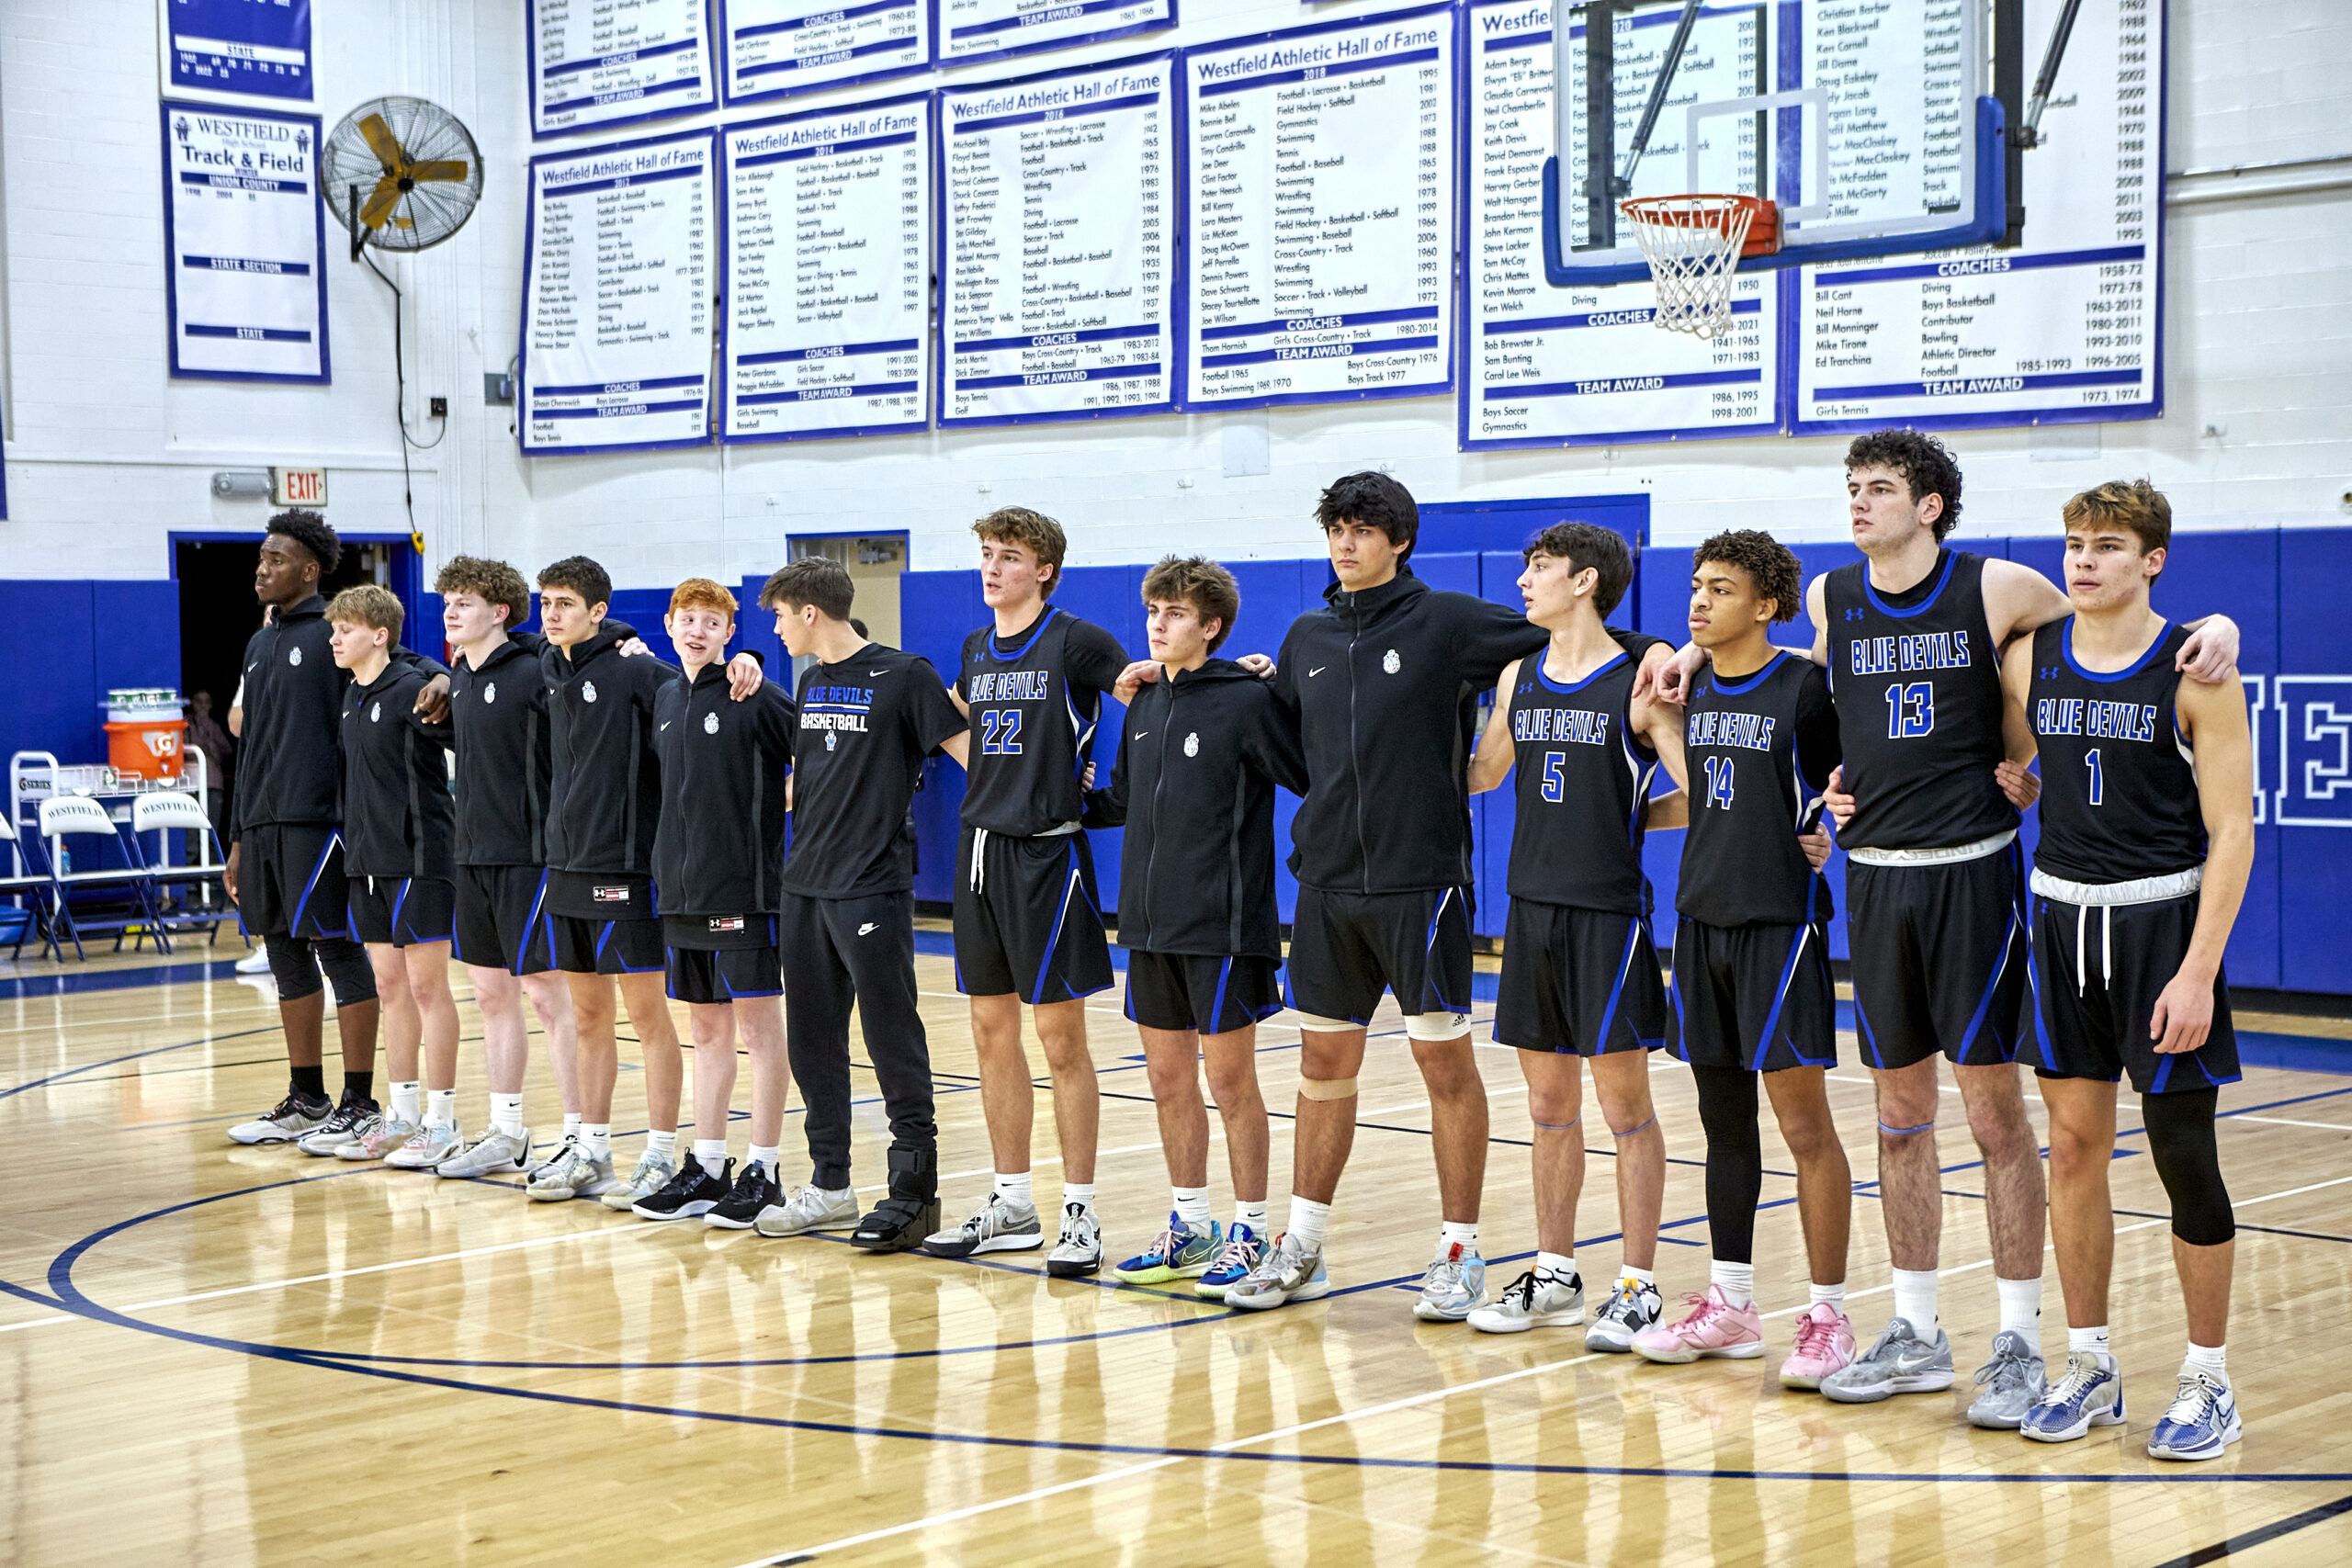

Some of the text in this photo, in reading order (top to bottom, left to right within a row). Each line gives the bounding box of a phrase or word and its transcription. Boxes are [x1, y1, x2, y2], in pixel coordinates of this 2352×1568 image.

[804, 11, 844, 28] COACHES
[1019, 6, 1083, 27] TEAM AWARD
[227, 44, 254, 60] STATE
[950, 38, 999, 53] Boys Swimming
[602, 51, 638, 67] COACHES
[797, 51, 852, 69] TEAM AWARD
[1198, 28, 1438, 81] Westfield Athletic Hall of Fame
[1304, 68, 1327, 81] 2018
[1419, 68, 1438, 80] 1995
[952, 74, 1160, 118] Westfield Athletic Hall of Fame
[1277, 75, 1385, 102] Football Lacrosse Basketball
[594, 90, 643, 106] TEAM AWARD
[1277, 95, 1355, 116] Field Hockey Softball
[1199, 100, 1240, 113] Mike Abeles
[1045, 109, 1065, 122] 2016
[197, 118, 289, 141] WESTFIELD
[1276, 117, 1318, 131] Gymnastics
[735, 114, 918, 154] Westfield Athletic Hall of Fame
[181, 145, 304, 173] Track & Field
[815, 146, 834, 157] 2014
[1485, 147, 1545, 163] David Demarest
[543, 149, 705, 184] Westfield Athletic Hall of Fame
[209, 175, 279, 191] UNION COUNTY
[1839, 172, 1887, 185] McFadden
[210, 258, 282, 274] STATE SECTION
[1938, 258, 2011, 277] COACHES
[1333, 284, 1368, 298] Volleyball
[1738, 280, 1759, 291] 1950
[1921, 283, 1951, 296] Diving
[2099, 282, 2143, 295] 1972-78
[1571, 295, 1597, 307] Diving
[1921, 294, 1996, 312] Boys Basketball
[1588, 310, 1650, 327] COACHES
[1815, 305, 1863, 318] Neil Horne
[1286, 316, 1342, 332] COACHES
[1396, 322, 1438, 334] 1980-2014
[1921, 314, 1973, 328] Contributor
[236, 327, 265, 340] STATE
[1032, 333, 1078, 347] COACHES
[1274, 329, 1372, 346] Girls Cross-Country Track
[1921, 332, 1959, 344] Bowling
[1123, 339, 1159, 350] 1983-2012
[1202, 340, 1248, 353] Thom Hornish
[1485, 337, 1545, 351] Bob Brewster Jr.
[1713, 336, 1759, 348] 1941-1965
[805, 347, 844, 360] COACHES
[887, 355, 919, 366] 1991-2003
[1275, 344, 1353, 361] TEAM AWARD
[1921, 346, 1996, 361] Athletic Director
[1348, 353, 1438, 370] Boys Cross-Country 1976
[2015, 355, 2142, 373] 1985-1993 1996-2005
[1023, 370, 1088, 386] TEAM AWARD
[1202, 369, 1249, 382] Football 1965
[1348, 370, 1406, 385] Boys Track 1977
[1921, 365, 1958, 378] Football
[605, 381, 641, 394] COACHES
[797, 387, 853, 401] TEAM AWARD
[1575, 378, 1664, 395] TEAM AWARD
[1922, 377, 2023, 396] TEAM AWARD
[1713, 390, 1759, 403] 1986, 1995
[2082, 388, 2141, 404] 1973, 1974
[597, 404, 647, 419] TEAM AWARD
[956, 406, 968, 417] Golf
[1483, 406, 1529, 419] Boys Soccer
[1712, 407, 1758, 420] 1998-2001
[1815, 403, 1869, 417] Girls Tennis
[737, 420, 760, 430] Baseball
[1482, 422, 1527, 434] Gymnastics
[288, 472, 319, 501] EXIT
[1851, 630, 1971, 675] BLUE DEVILS
[806, 686, 873, 705] BLUE DEVILS
[969, 671, 1048, 704] BLUE DEVILS
[1884, 681, 1935, 739] 13
[800, 713, 868, 733] BASKETBALL
[1516, 709, 1609, 746] BLUE DEVILS
[2037, 698, 2156, 743] BLUE DEVILS
[981, 708, 1023, 755] 22
[1690, 712, 1776, 751] BLUE DEVILS
[157, 735, 172, 751] G
[1541, 751, 1566, 803] 5
[1703, 755, 1735, 811] 14
[2085, 748, 2103, 806] 1
[48, 805, 102, 819] WESTFIELD
[141, 802, 198, 816] WESTFIELD
